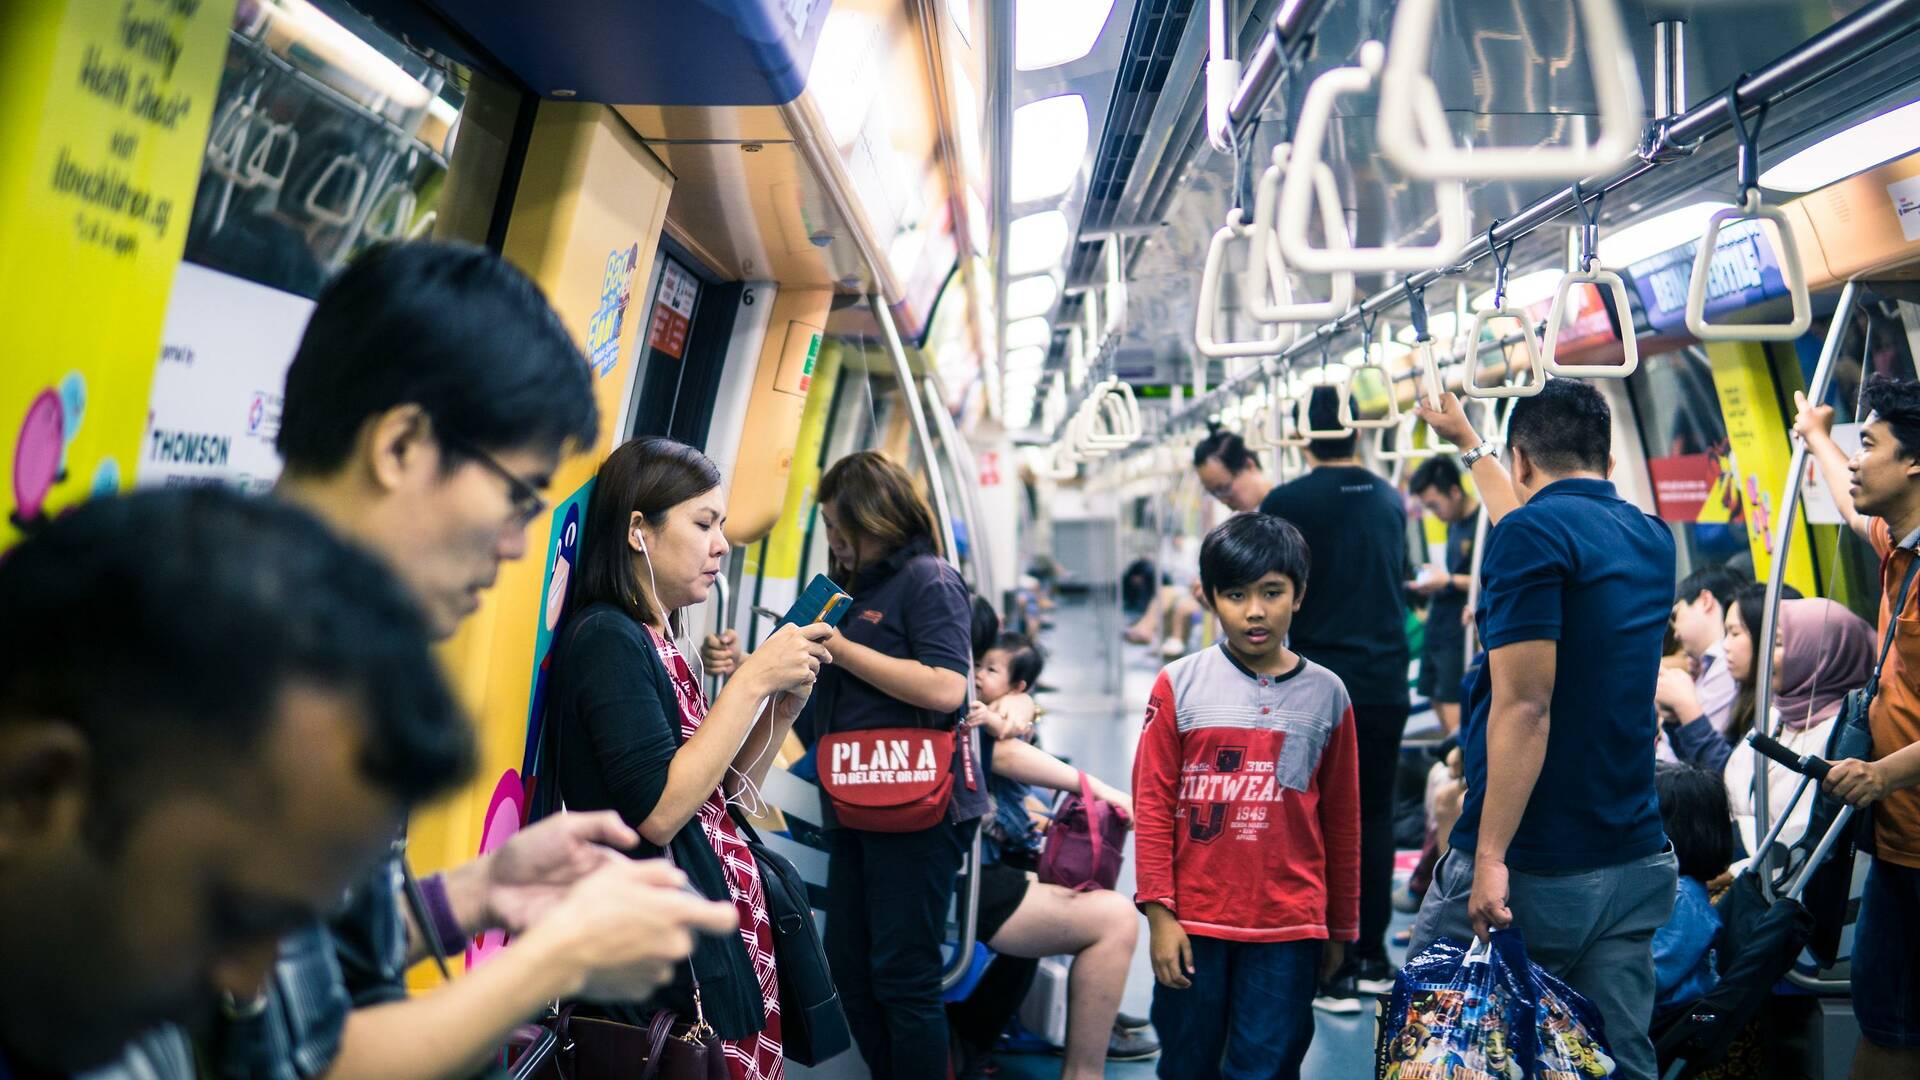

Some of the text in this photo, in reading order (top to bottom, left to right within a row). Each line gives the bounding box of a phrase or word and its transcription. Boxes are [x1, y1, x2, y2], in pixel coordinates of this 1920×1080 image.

[743, 289, 754, 305] 6
[152, 430, 230, 466] THOMSON
[832, 740, 909, 772] PLAN
[917, 739, 937, 770] A
[1246, 761, 1274, 772] 3105
[831, 770, 936, 785] TO BELIEVE OR NOT
[1236, 807, 1267, 820] 1949
